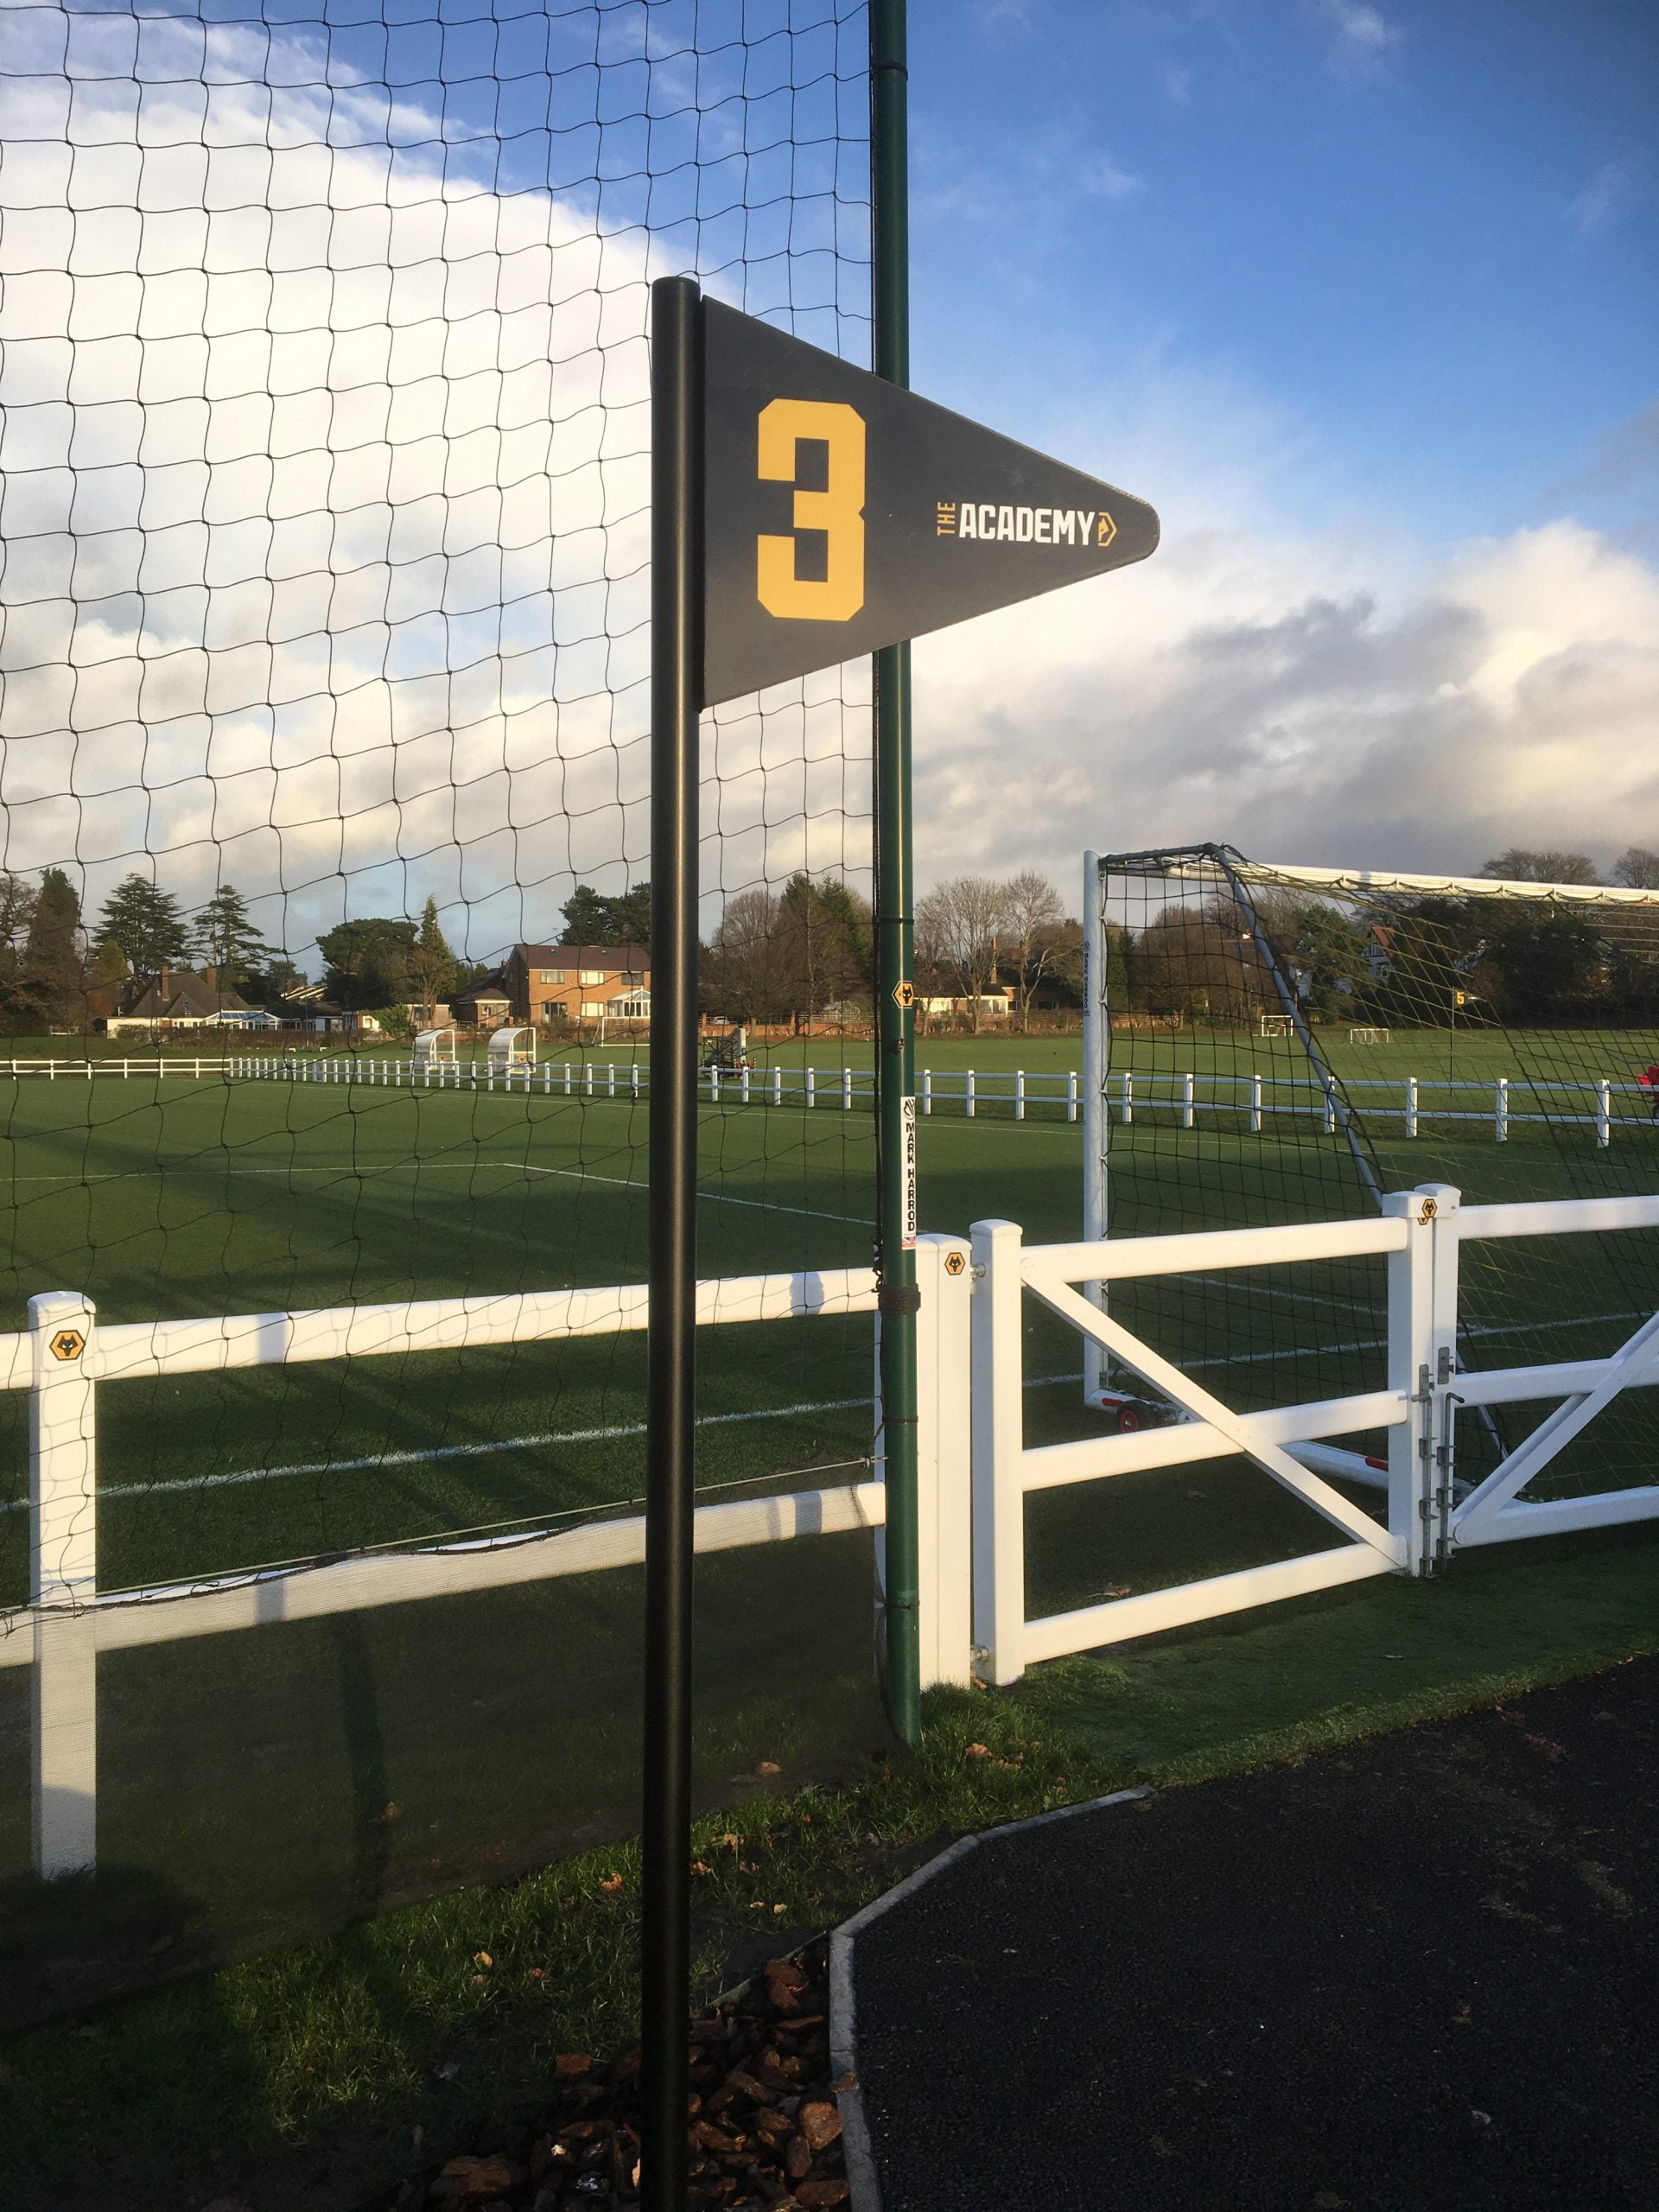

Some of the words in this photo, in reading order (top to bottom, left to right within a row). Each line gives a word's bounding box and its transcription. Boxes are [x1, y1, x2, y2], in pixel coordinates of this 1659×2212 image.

[757, 398, 866, 621] 3
[937, 501, 956, 537] THE
[959, 503, 1096, 546] ACADEMY
[1457, 991, 1465, 1005] 5
[906, 1122, 915, 1164] MARK
